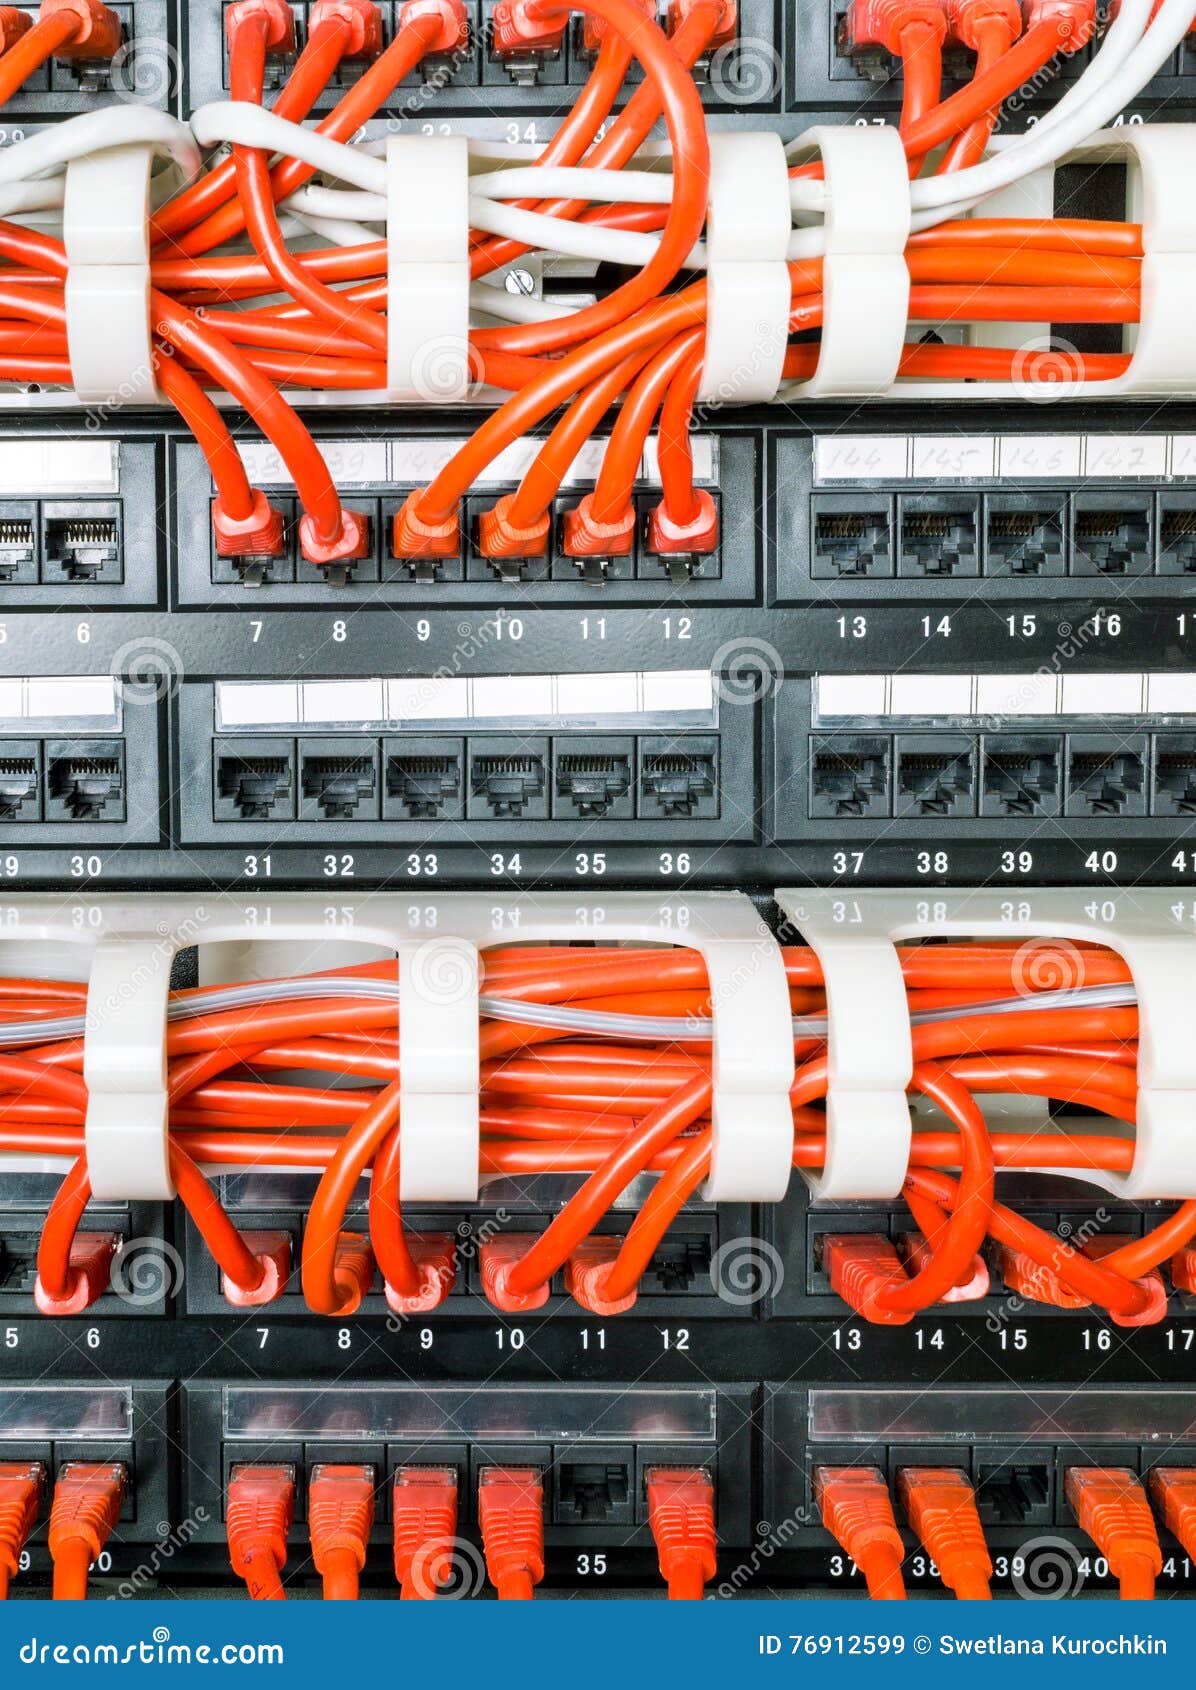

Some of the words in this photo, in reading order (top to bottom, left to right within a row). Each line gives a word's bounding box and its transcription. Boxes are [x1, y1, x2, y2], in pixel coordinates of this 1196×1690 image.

[506, 122, 538, 144] 34
[77, 622, 90, 643] 6
[250, 622, 262, 642] 7
[332, 620, 347, 642] 8
[416, 620, 430, 641] 9
[494, 619, 523, 640] 10
[581, 619, 605, 639] 11
[662, 618, 691, 639] 12
[836, 617, 867, 638] 13
[921, 616, 952, 638] 14
[1006, 615, 1037, 637] 15
[1092, 614, 1121, 636] 16
[0, 856, 18, 876] 9
[71, 855, 101, 877] 30
[244, 855, 271, 876] 31
[323, 855, 354, 876] 32
[407, 854, 438, 875] 33
[491, 854, 522, 875] 34
[576, 853, 606, 874] 35
[659, 853, 690, 874] 36
[833, 852, 864, 873] 37
[917, 852, 948, 873] 38
[1001, 851, 1033, 873] 39
[1085, 851, 1117, 872] 40
[5, 1327, 18, 1348] 5
[87, 1328, 100, 1349] 6
[257, 1328, 269, 1349] 7
[338, 1328, 351, 1349] 8
[420, 1329, 433, 1350] 9
[495, 1329, 525, 1350] 10
[580, 1329, 605, 1350] 11
[661, 1329, 690, 1350] 12
[832, 1329, 862, 1350] 13
[915, 1329, 944, 1350] 14
[998, 1329, 1028, 1350] 15
[1082, 1329, 1111, 1350] 16
[1166, 1329, 1195, 1350] 17
[576, 1555, 607, 1575] 35
[996, 1557, 1025, 1578] 39
[1078, 1557, 1109, 1578] 40
[1163, 1558, 1190, 1578] 41
